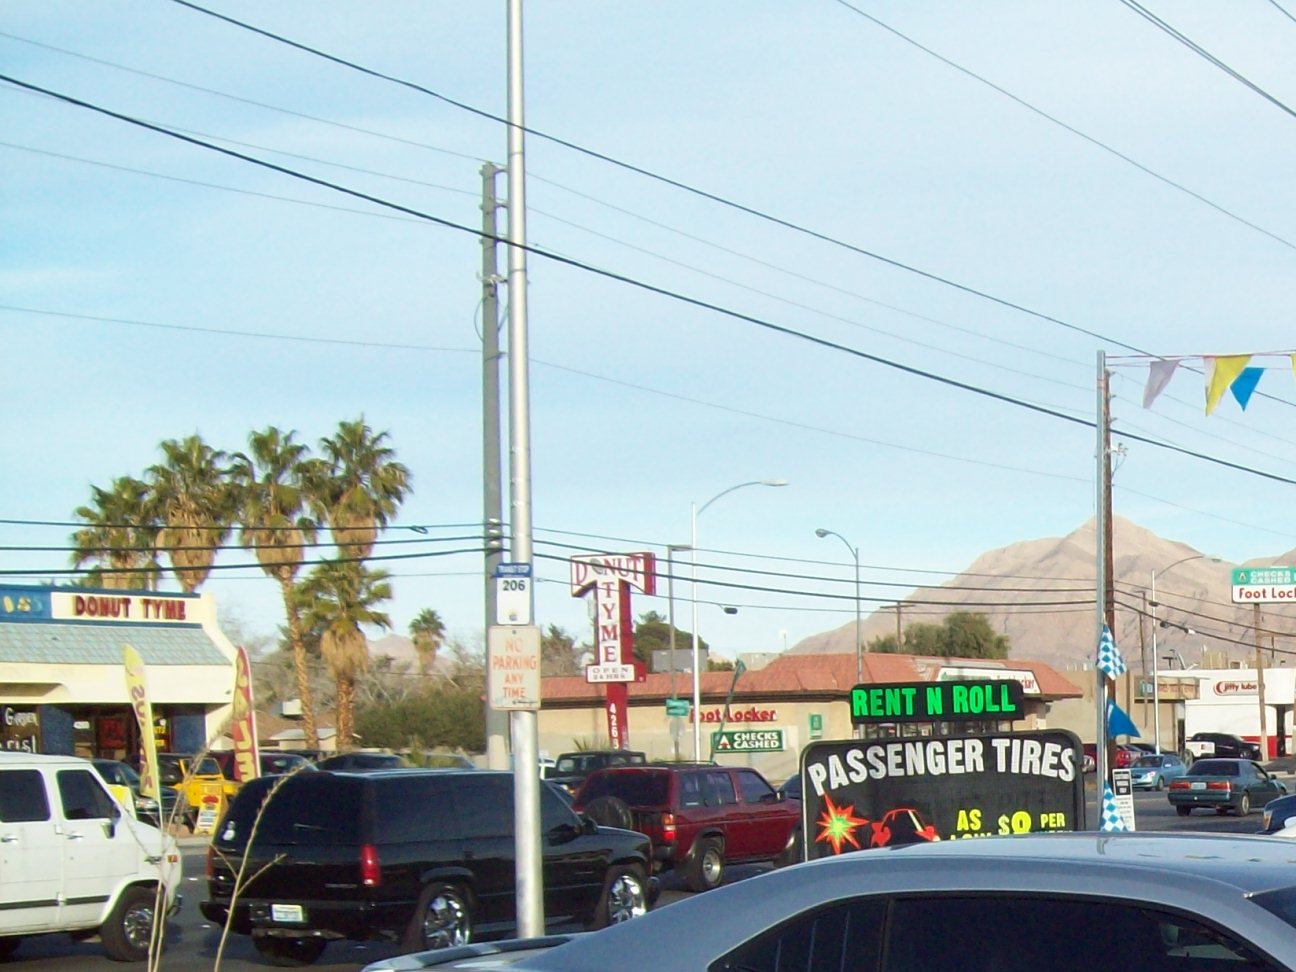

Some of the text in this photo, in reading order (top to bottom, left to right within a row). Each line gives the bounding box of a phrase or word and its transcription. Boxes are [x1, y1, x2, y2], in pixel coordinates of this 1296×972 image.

[502, 579, 526, 591] 206
[1239, 587, 1267, 599] Foot
[74, 595, 186, 620] DONUT TYME
[504, 638, 524, 653] NO
[492, 655, 537, 670] PARKING
[504, 673, 524, 685] ANY
[502, 687, 526, 698] TIME
[852, 684, 1017, 717] RENT N ROLL
[727, 706, 777, 723] Locker
[733, 731, 778, 742] CHECKS
[733, 740, 780, 750] CASHED
[808, 738, 1076, 797] PASSENGER TIRES
[957, 809, 982, 831] AS
[1040, 812, 1066, 829] PER
